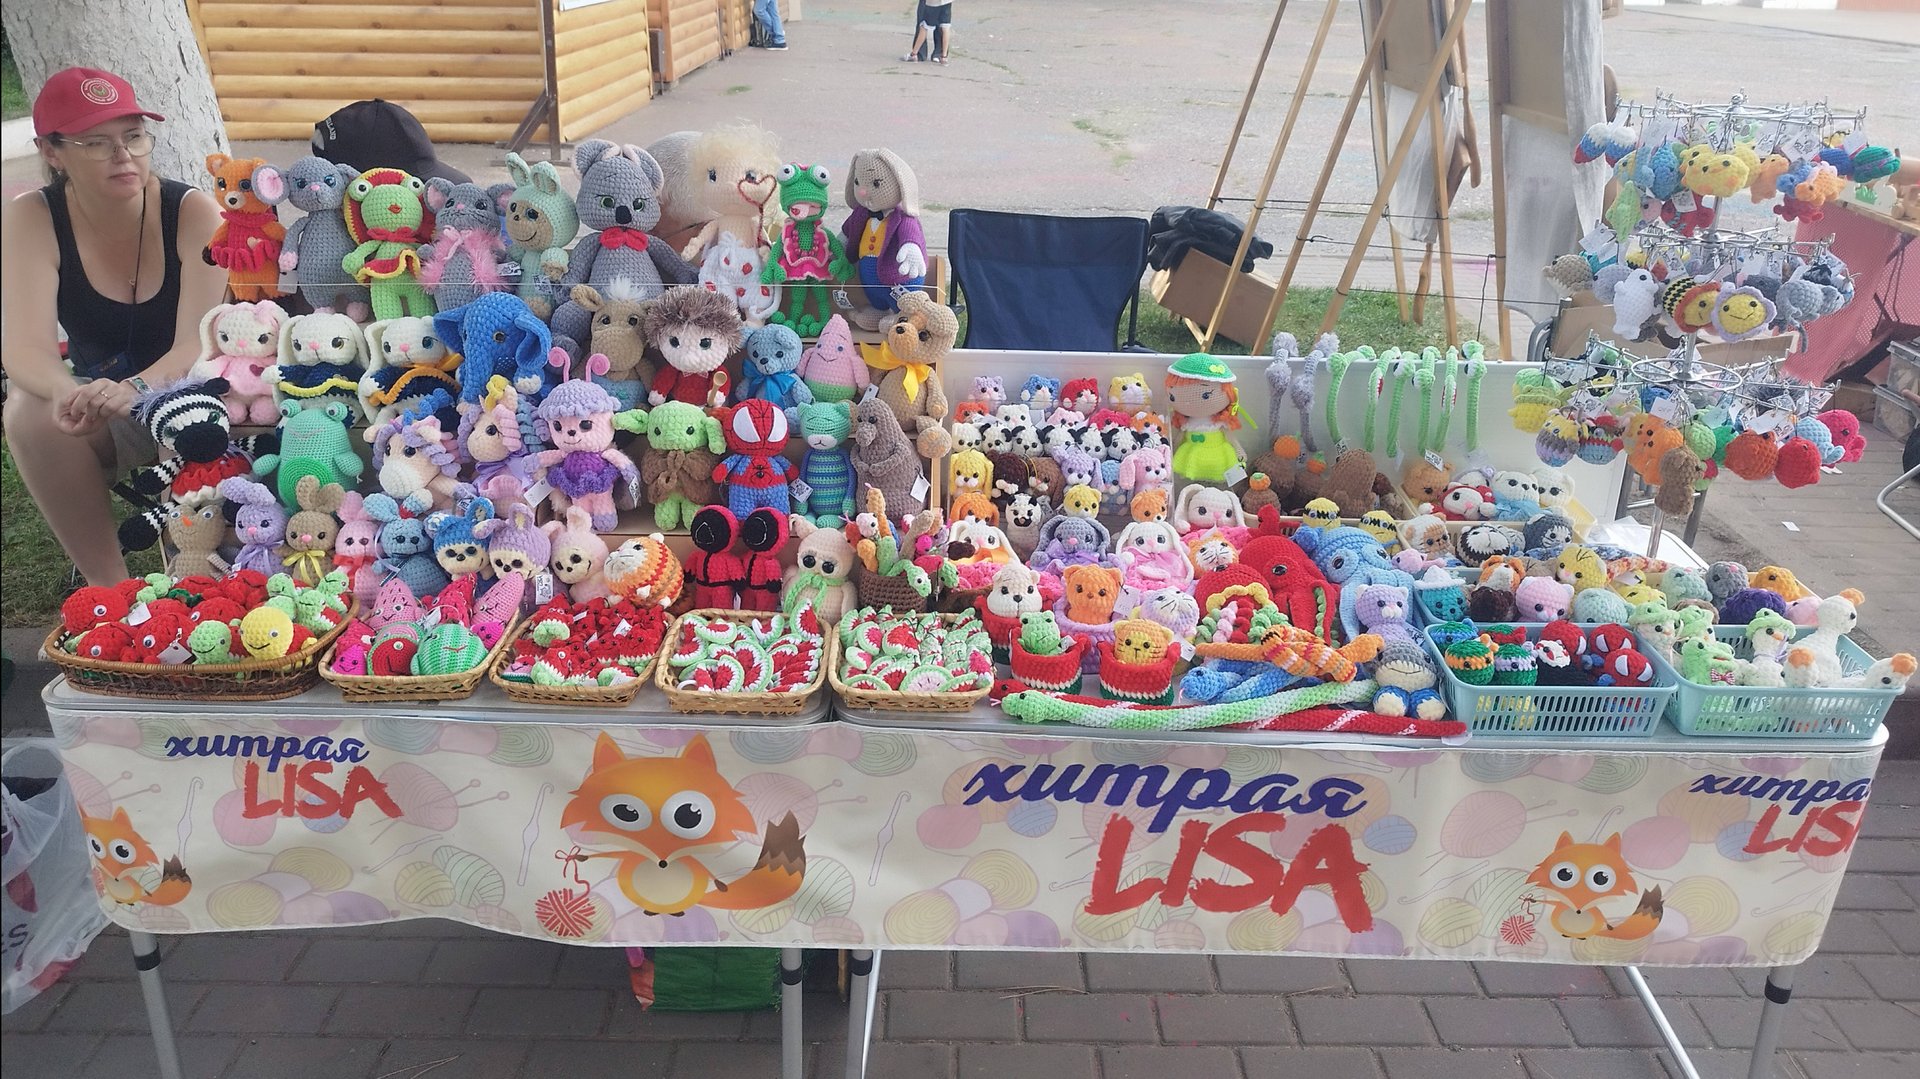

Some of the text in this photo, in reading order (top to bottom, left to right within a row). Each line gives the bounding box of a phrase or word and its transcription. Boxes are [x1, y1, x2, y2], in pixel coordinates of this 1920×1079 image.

[165, 734, 369, 772] хитрая
[242, 761, 404, 819] LISA
[963, 763, 1368, 833] хитрая
[1689, 774, 1871, 815] хитра
[1743, 801, 1864, 856] LIS
[1084, 812, 1373, 933] LISA
